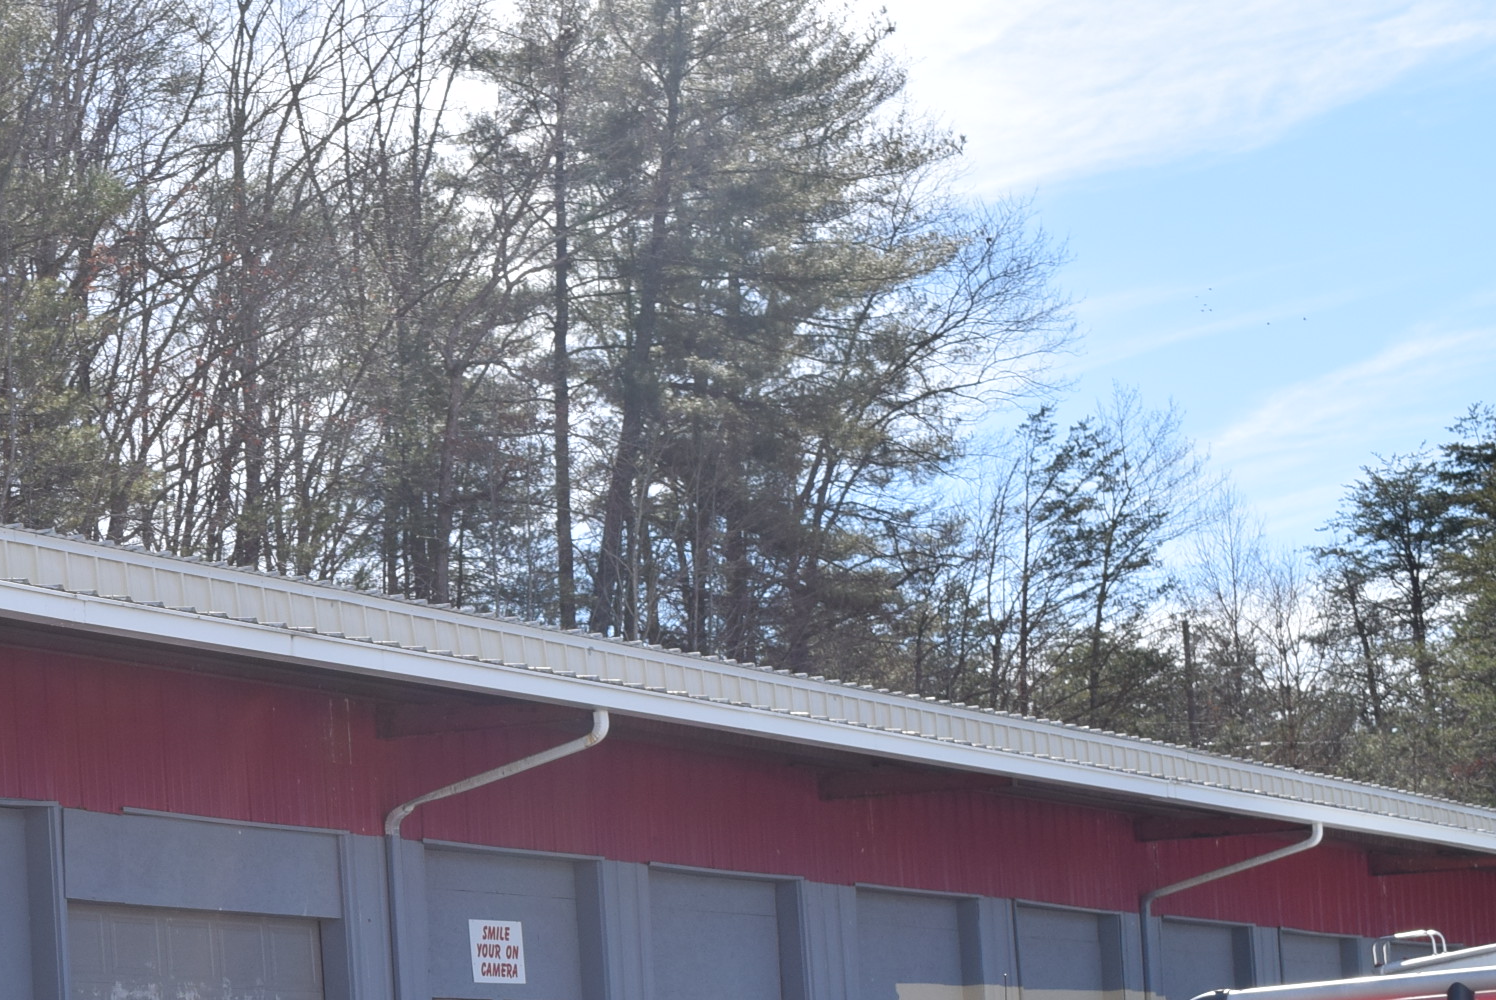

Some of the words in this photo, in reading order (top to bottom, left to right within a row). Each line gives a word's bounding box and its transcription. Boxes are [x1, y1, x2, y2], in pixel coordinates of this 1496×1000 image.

[482, 925, 510, 941] SMILE
[477, 943, 501, 960] YOUR
[506, 945, 519, 960] ON
[481, 962, 518, 979] CAMERA
